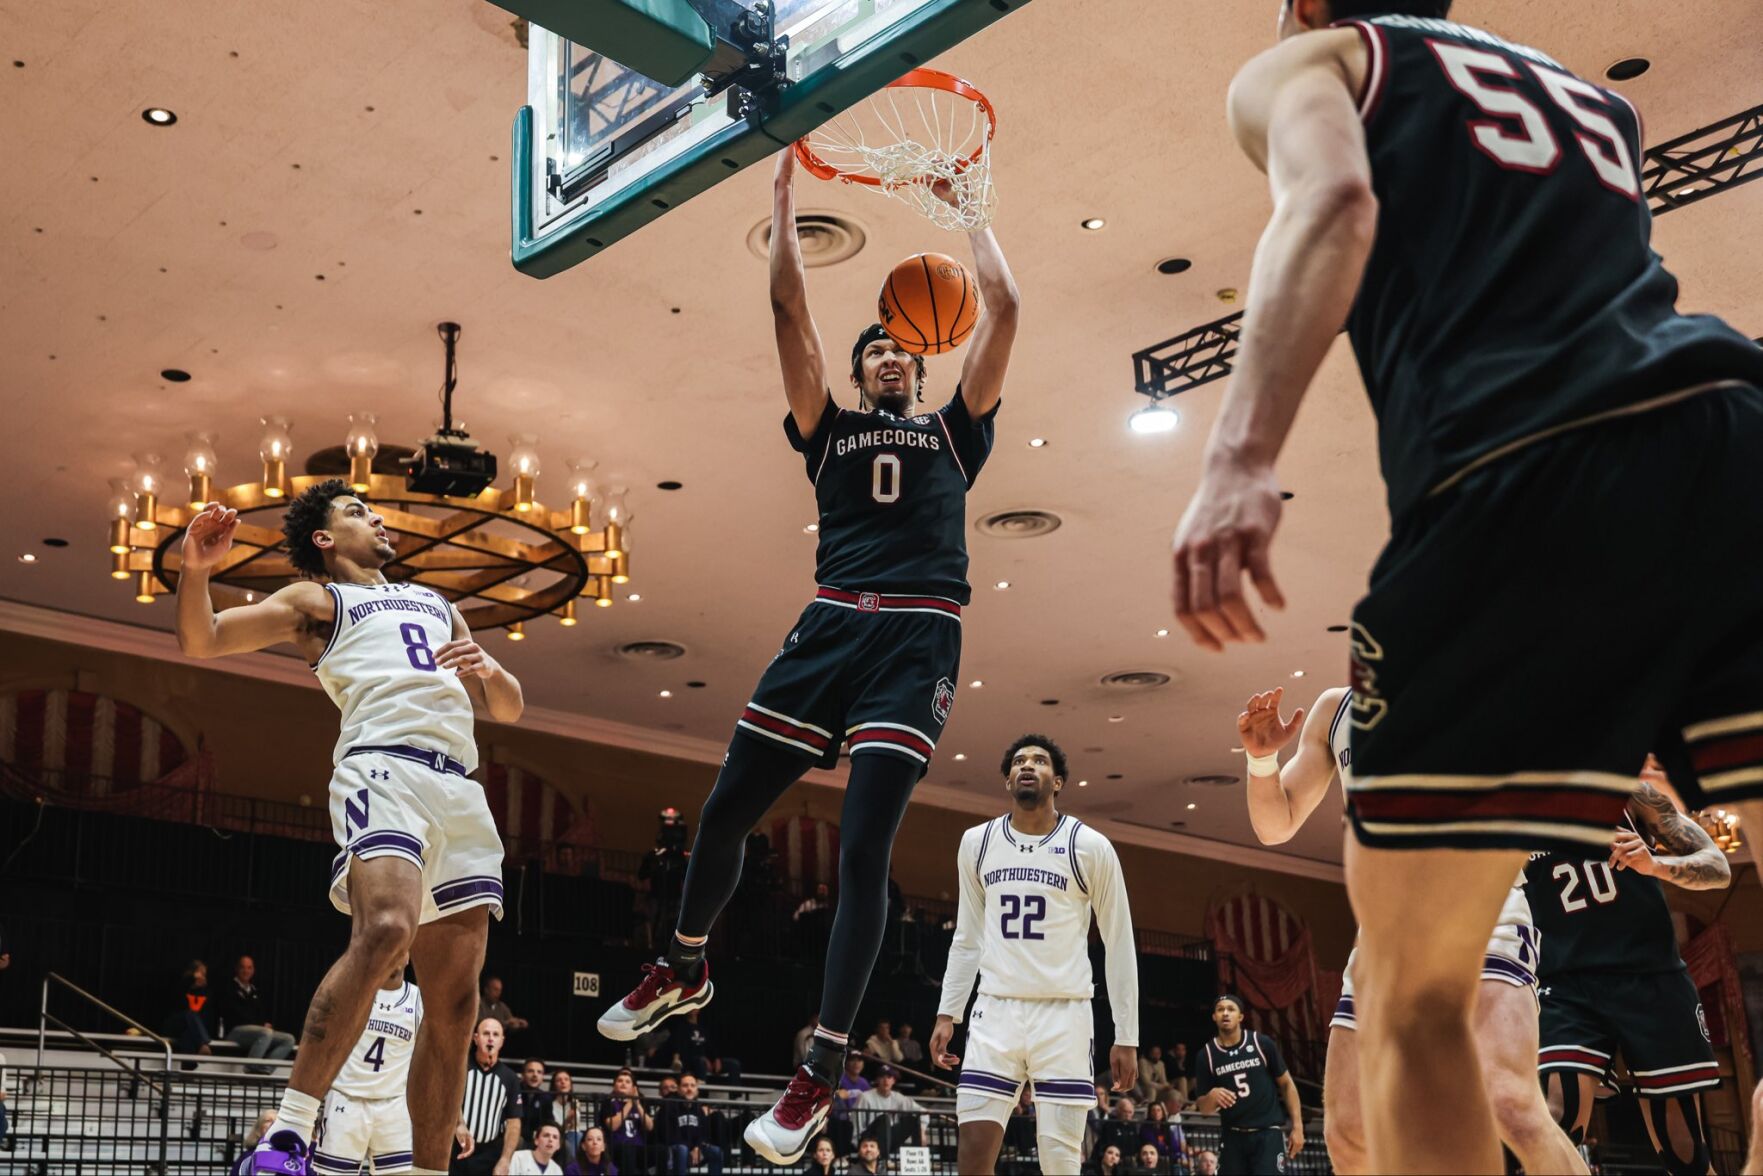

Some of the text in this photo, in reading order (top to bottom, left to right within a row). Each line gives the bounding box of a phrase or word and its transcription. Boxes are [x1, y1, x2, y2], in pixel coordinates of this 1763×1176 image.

[1424, 38, 1640, 201] 55
[836, 429, 940, 456] GAMECOCKS
[872, 453, 901, 504] 0
[348, 599, 448, 627] NORTHWESTERN
[400, 622, 437, 672] 8
[435, 753, 446, 771] N
[345, 788, 370, 842] N
[984, 867, 1068, 892] NORTHWESTERN
[1552, 859, 1617, 913] 20
[1000, 894, 1047, 940] 22
[575, 976, 598, 992] 108
[368, 1018, 413, 1042] HWESTERN
[363, 1036, 386, 1072] 4
[1215, 1057, 1261, 1076] GAMECOCKS
[1234, 1073, 1250, 1098] 5
